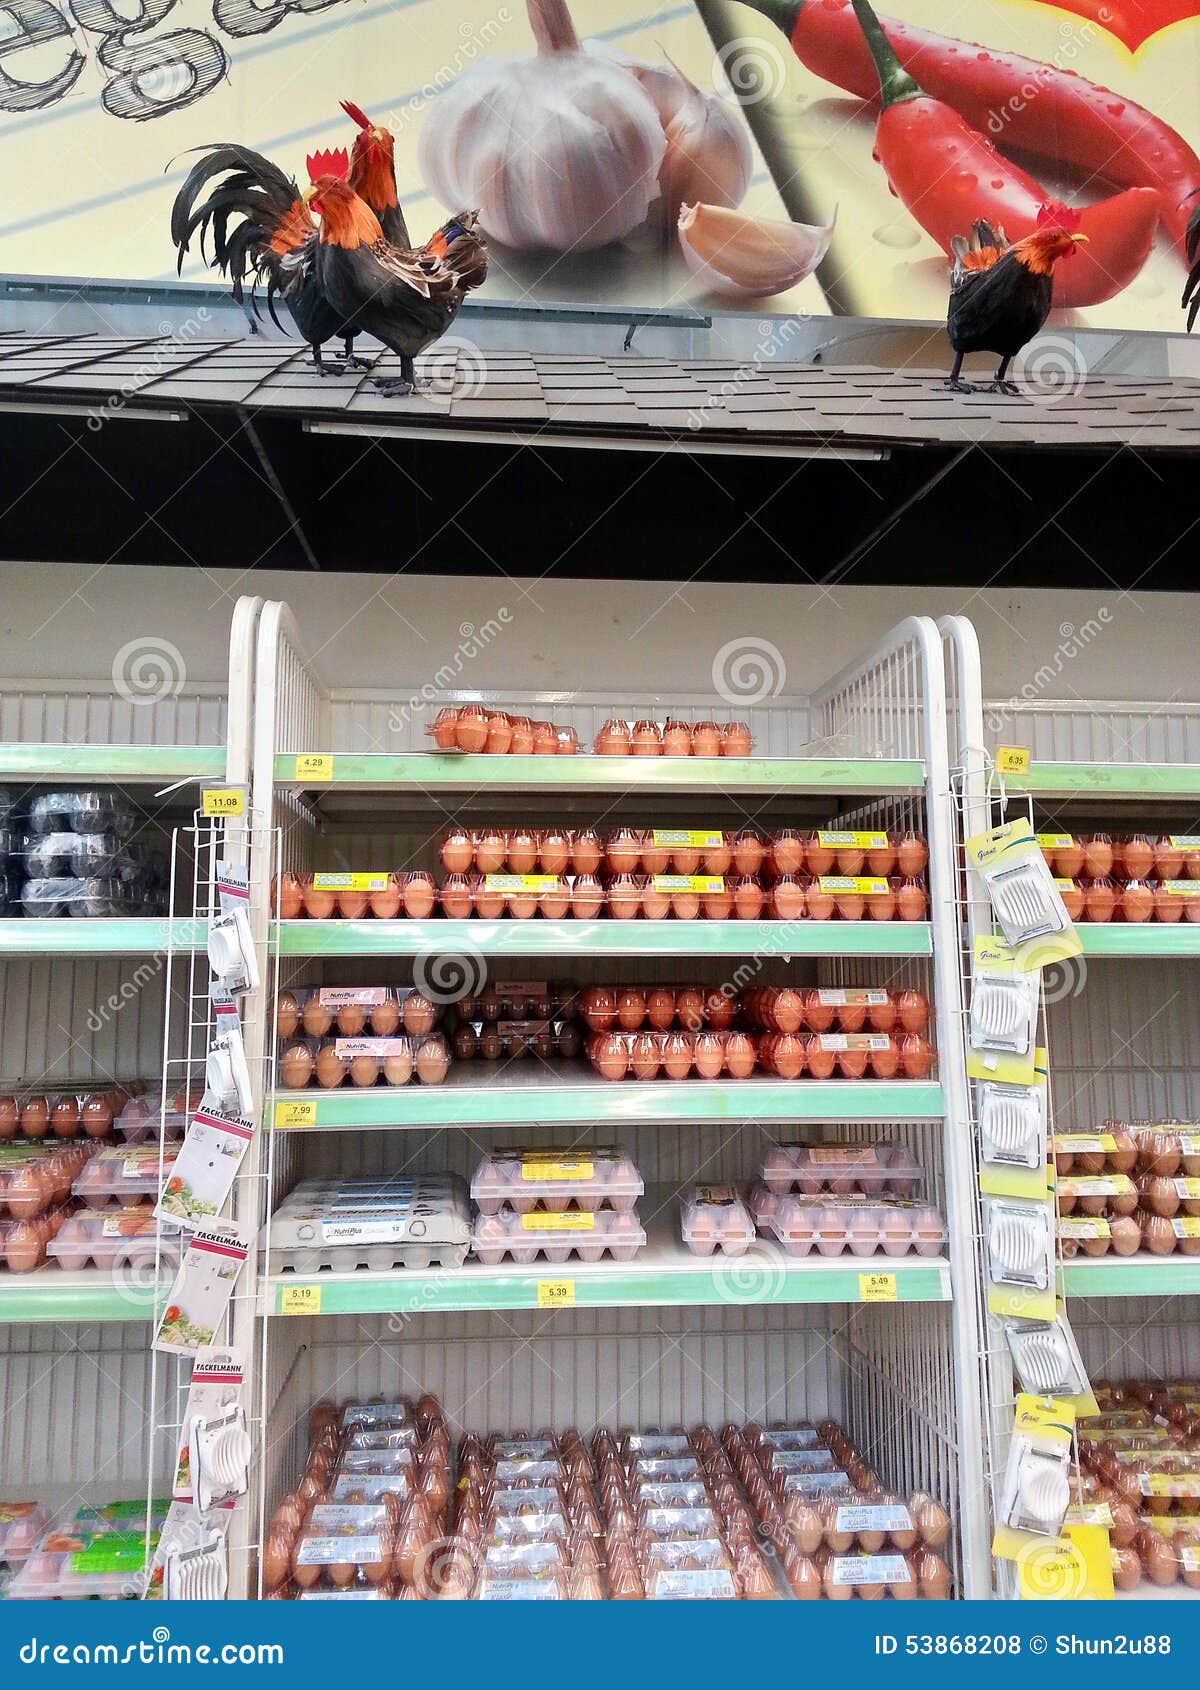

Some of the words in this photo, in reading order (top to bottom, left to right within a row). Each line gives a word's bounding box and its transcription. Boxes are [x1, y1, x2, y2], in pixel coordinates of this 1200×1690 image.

[303, 758, 323, 767] 4.29
[212, 797, 238, 806] 11.08
[292, 1106, 311, 1115] 7.99
[871, 1276, 888, 1285] 5.49
[292, 1289, 311, 1298] 5.19
[549, 1287, 567, 1296] 5.39
[196, 1363, 242, 1372] FACKELMANN
